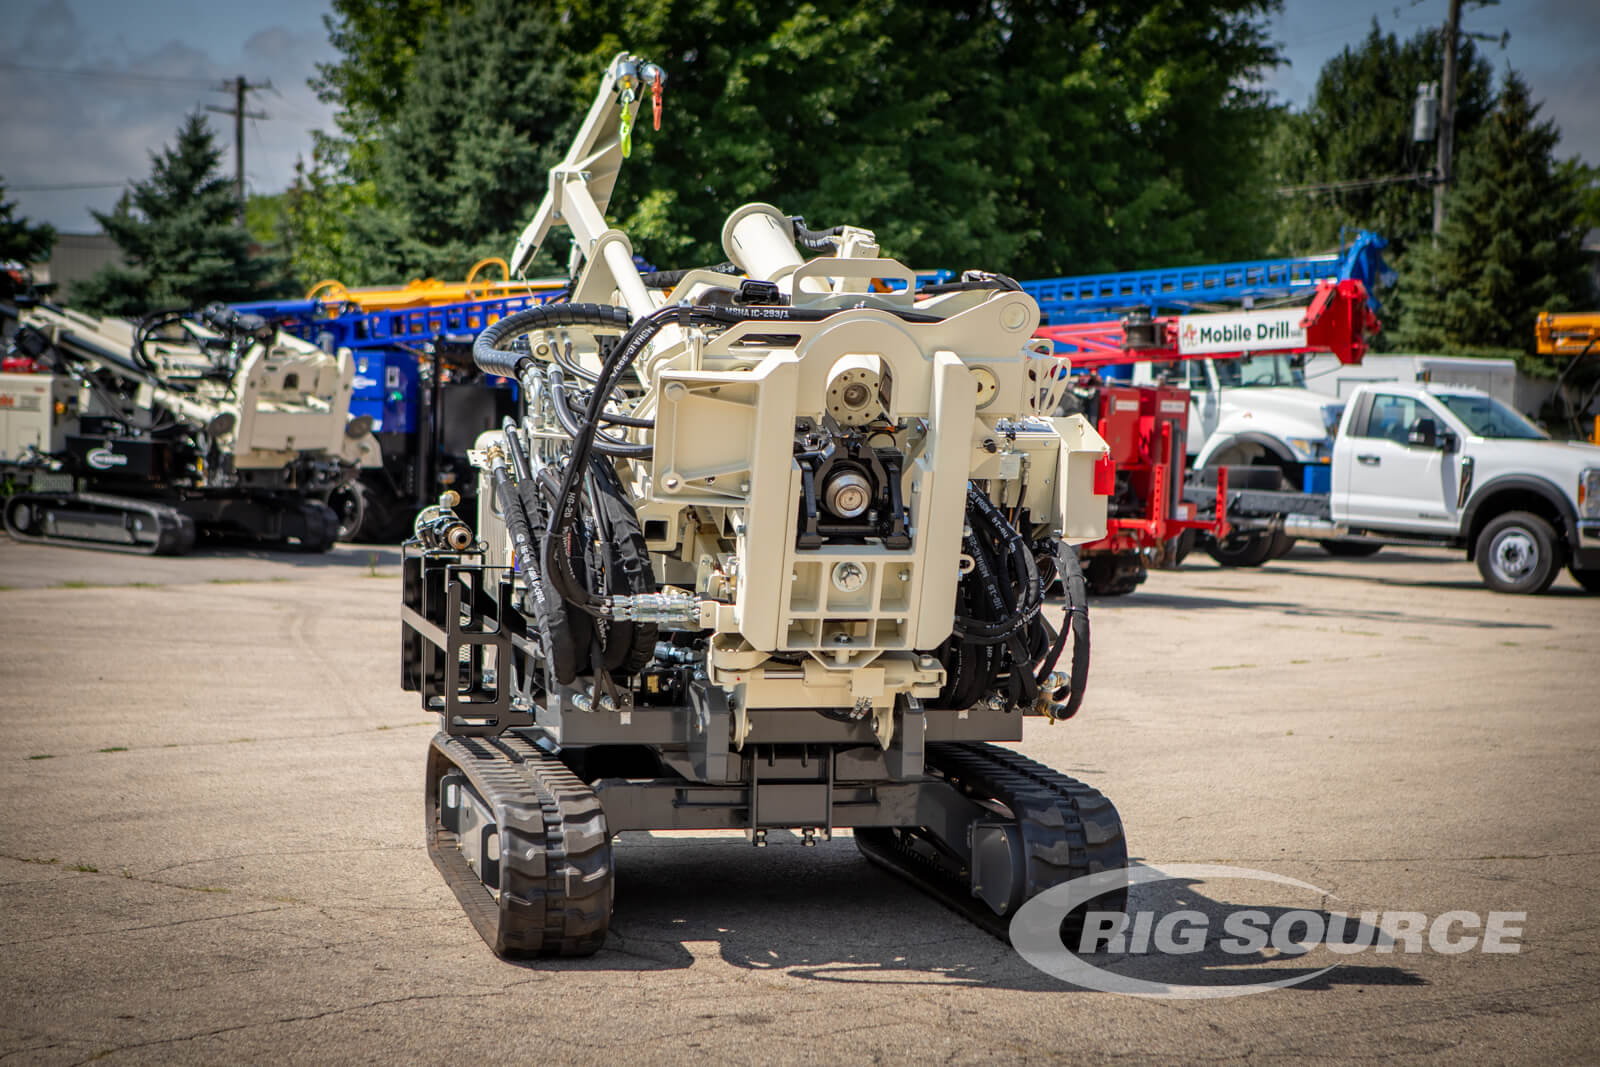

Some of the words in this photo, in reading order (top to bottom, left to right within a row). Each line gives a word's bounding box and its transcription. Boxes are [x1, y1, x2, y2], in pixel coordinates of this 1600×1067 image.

[725, 307, 749, 317] MSHA
[1200, 324, 1252, 344] Mobile
[1257, 321, 1289, 340] Drill
